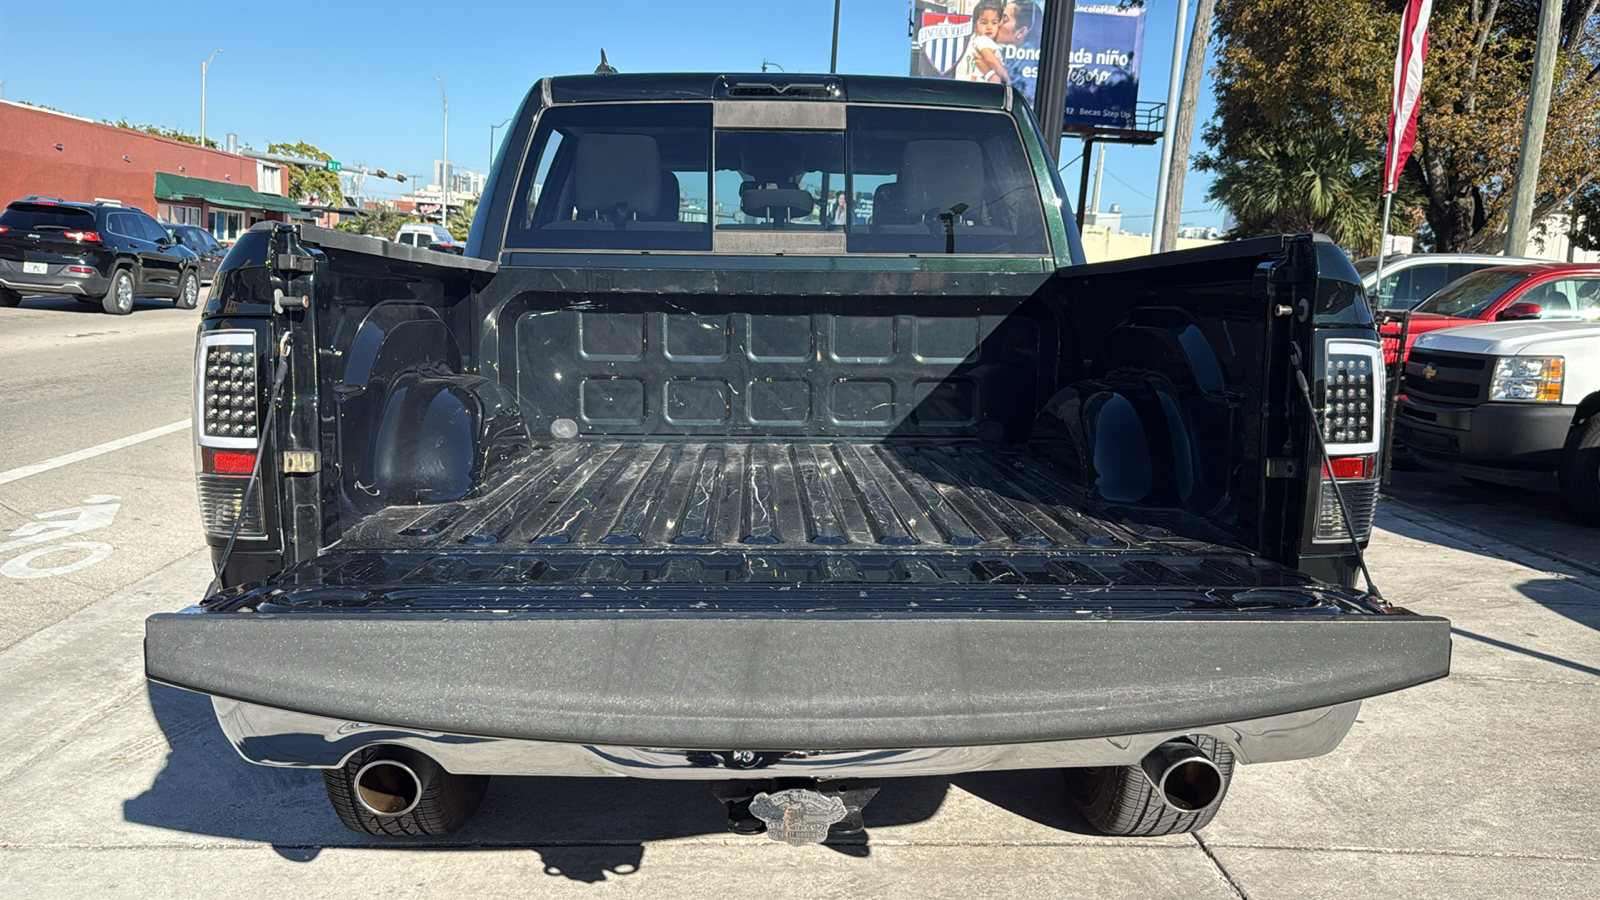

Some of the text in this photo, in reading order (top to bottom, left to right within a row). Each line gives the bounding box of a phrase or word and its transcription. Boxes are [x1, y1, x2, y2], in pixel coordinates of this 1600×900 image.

[920, 26, 949, 41] LINCOLN
[1096, 48, 1129, 66] niño
[1067, 64, 1111, 86] Tesoro
[1079, 107, 1101, 117] Becas
[1102, 109, 1119, 119] Step
[1120, 110, 1131, 119] Up
